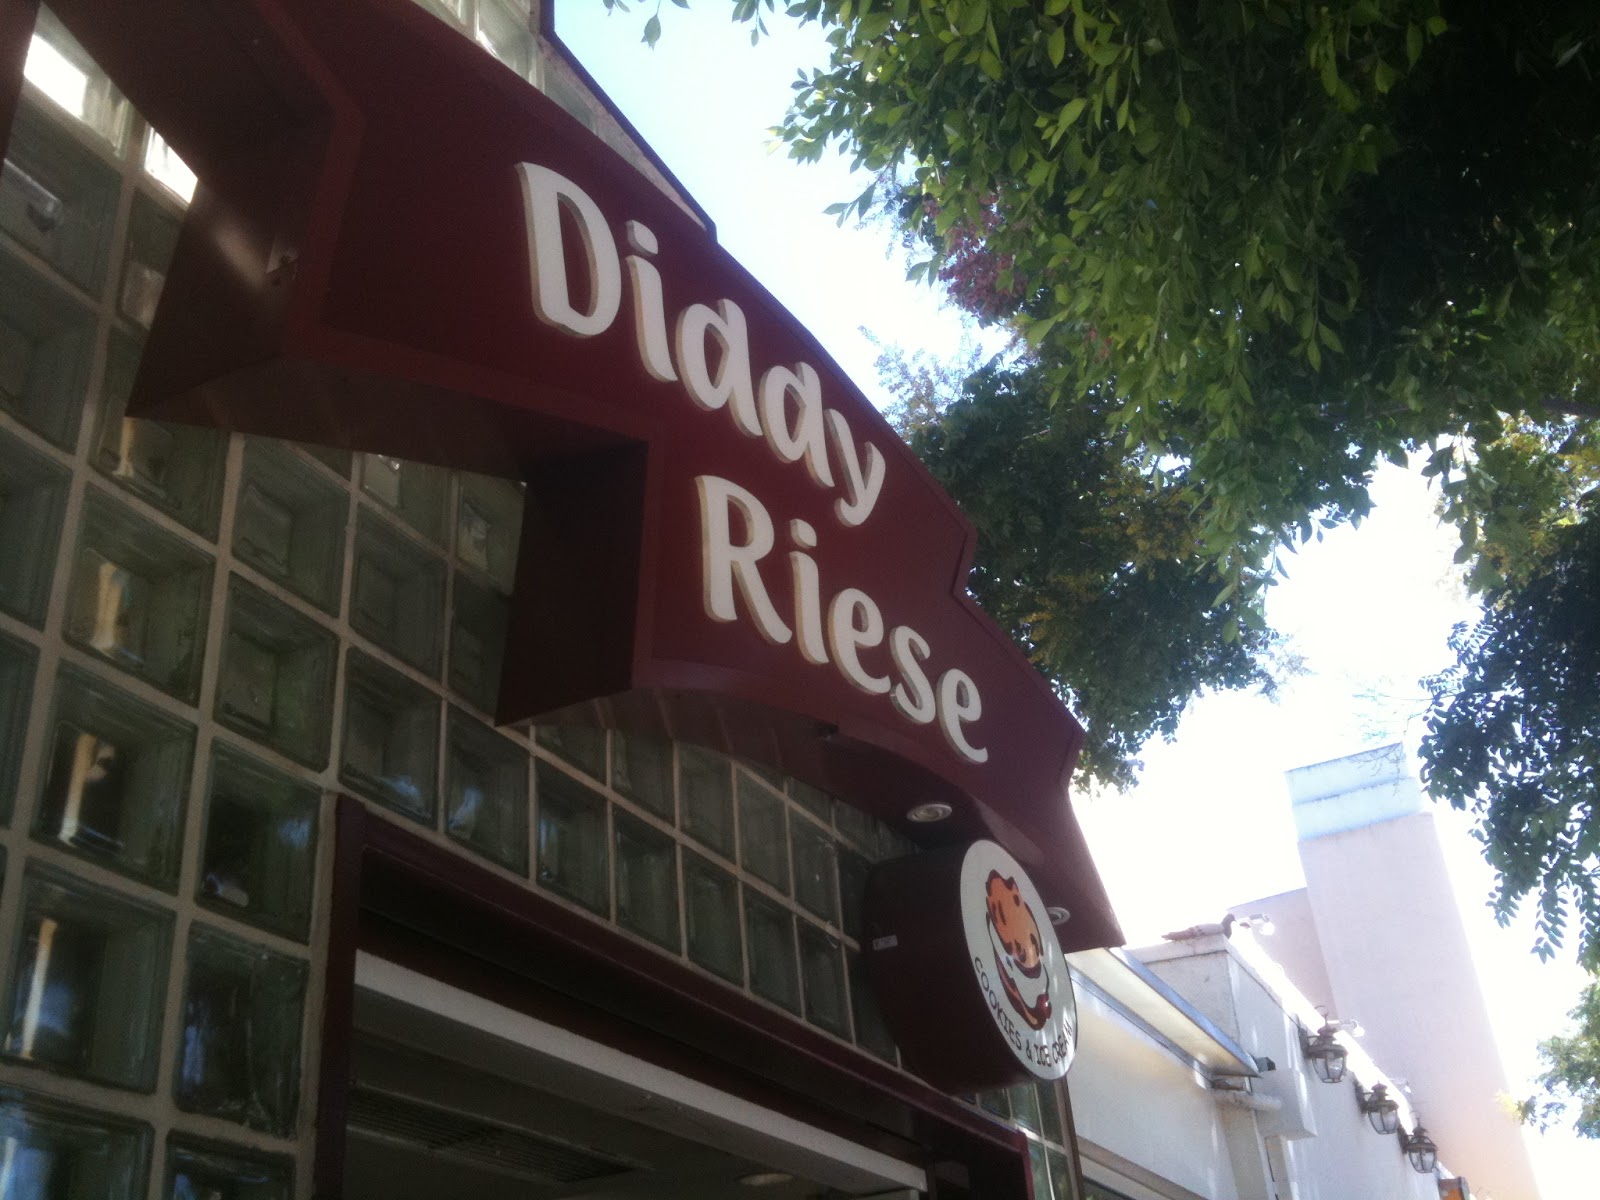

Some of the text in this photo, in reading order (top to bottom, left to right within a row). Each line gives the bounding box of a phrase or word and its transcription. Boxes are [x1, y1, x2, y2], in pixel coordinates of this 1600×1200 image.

[515, 161, 886, 527] Diddy
[694, 475, 988, 763] Riese
[975, 957, 1072, 1067] COOKIES & ICE CREAM
